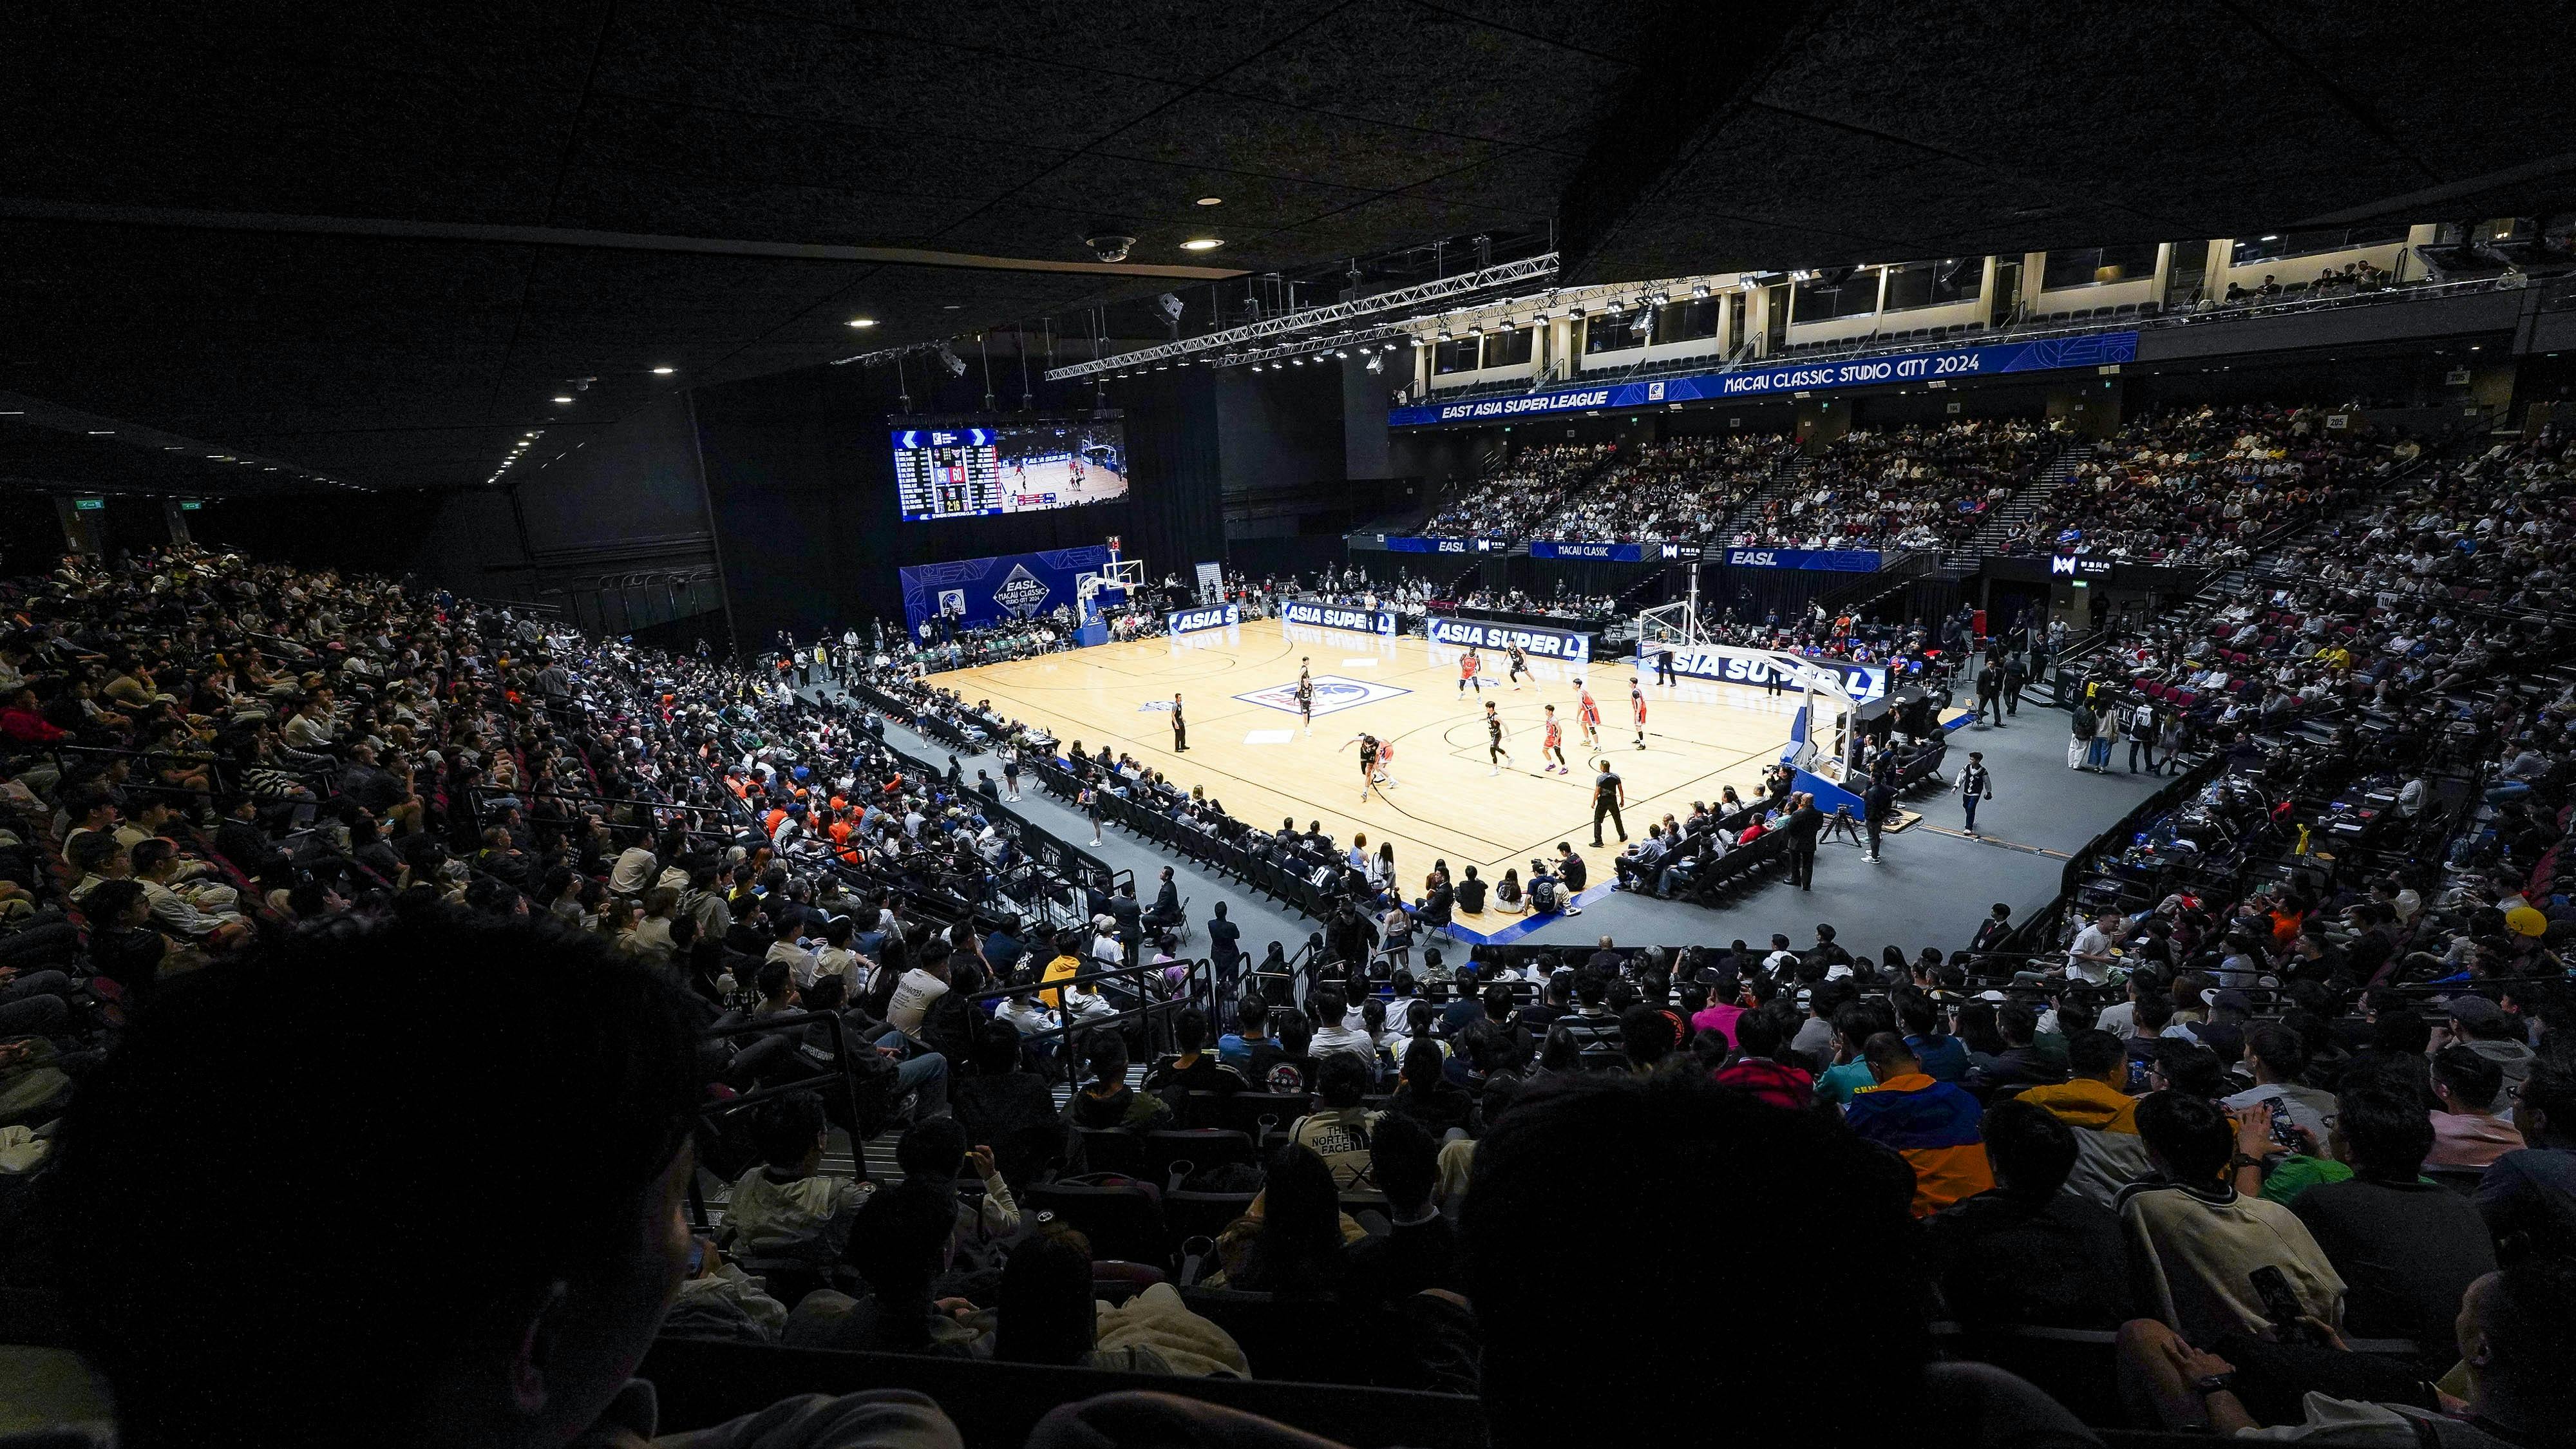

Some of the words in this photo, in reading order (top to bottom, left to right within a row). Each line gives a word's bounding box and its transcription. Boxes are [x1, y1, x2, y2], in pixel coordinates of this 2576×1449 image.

[1724, 375, 1769, 393] MACAU
[1774, 369, 1833, 388] CLASSIC
[1839, 363, 1891, 382] STUDIO
[1897, 359, 1929, 377] CITY
[1934, 354, 1979, 374] 2024
[1442, 405, 1473, 419] EAST
[1474, 402, 1502, 415] ASIA
[1502, 397, 1548, 413] SUPER
[1549, 391, 1608, 409] LEAGUE
[937, 469, 947, 482] 96
[952, 468, 962, 481] 60
[947, 500, 960, 511] 2:16
[1438, 542, 1465, 552] EASL
[1558, 545, 1581, 555] MACAU
[1584, 546, 1608, 556] CLASSIC
[1731, 552, 1777, 566] EASL
[1007, 580, 1036, 592] EASL
[999, 591, 1018, 601] MACAU
[1019, 588, 1045, 598] CLASSIC
[1178, 610, 1222, 631] ASIA
[1288, 605, 1321, 623] ASIA
[1436, 623, 1483, 645] ASIA
[1486, 629, 1561, 655] SUPER
[1327, 1125, 1349, 1135] THE
[1312, 1134, 1349, 1147] NORTH
[1321, 1144, 1349, 1155] FACE
